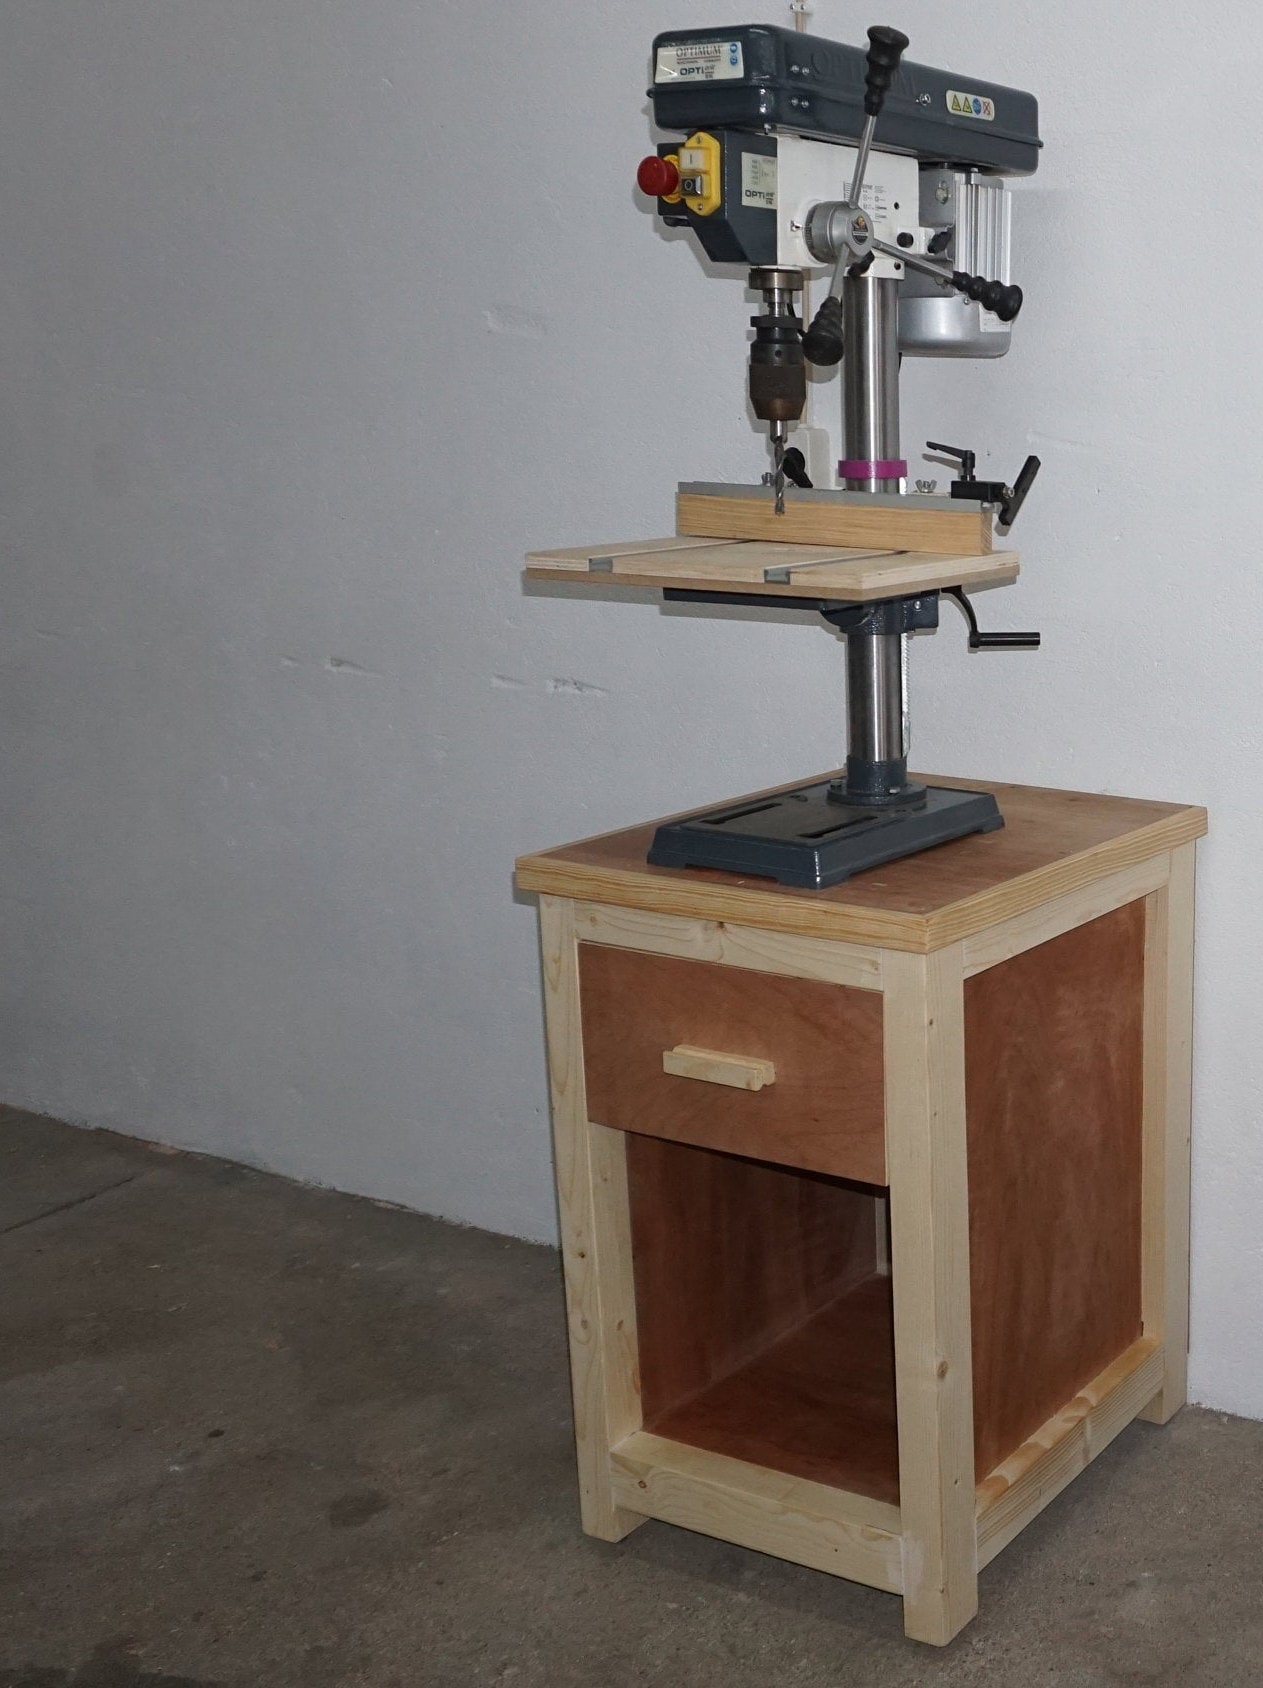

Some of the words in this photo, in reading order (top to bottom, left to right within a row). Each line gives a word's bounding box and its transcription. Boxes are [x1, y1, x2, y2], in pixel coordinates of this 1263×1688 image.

[676, 45, 721, 58] OPTIMUM
[680, 66, 704, 76] OPTI
[745, 190, 765, 199] OPTI
